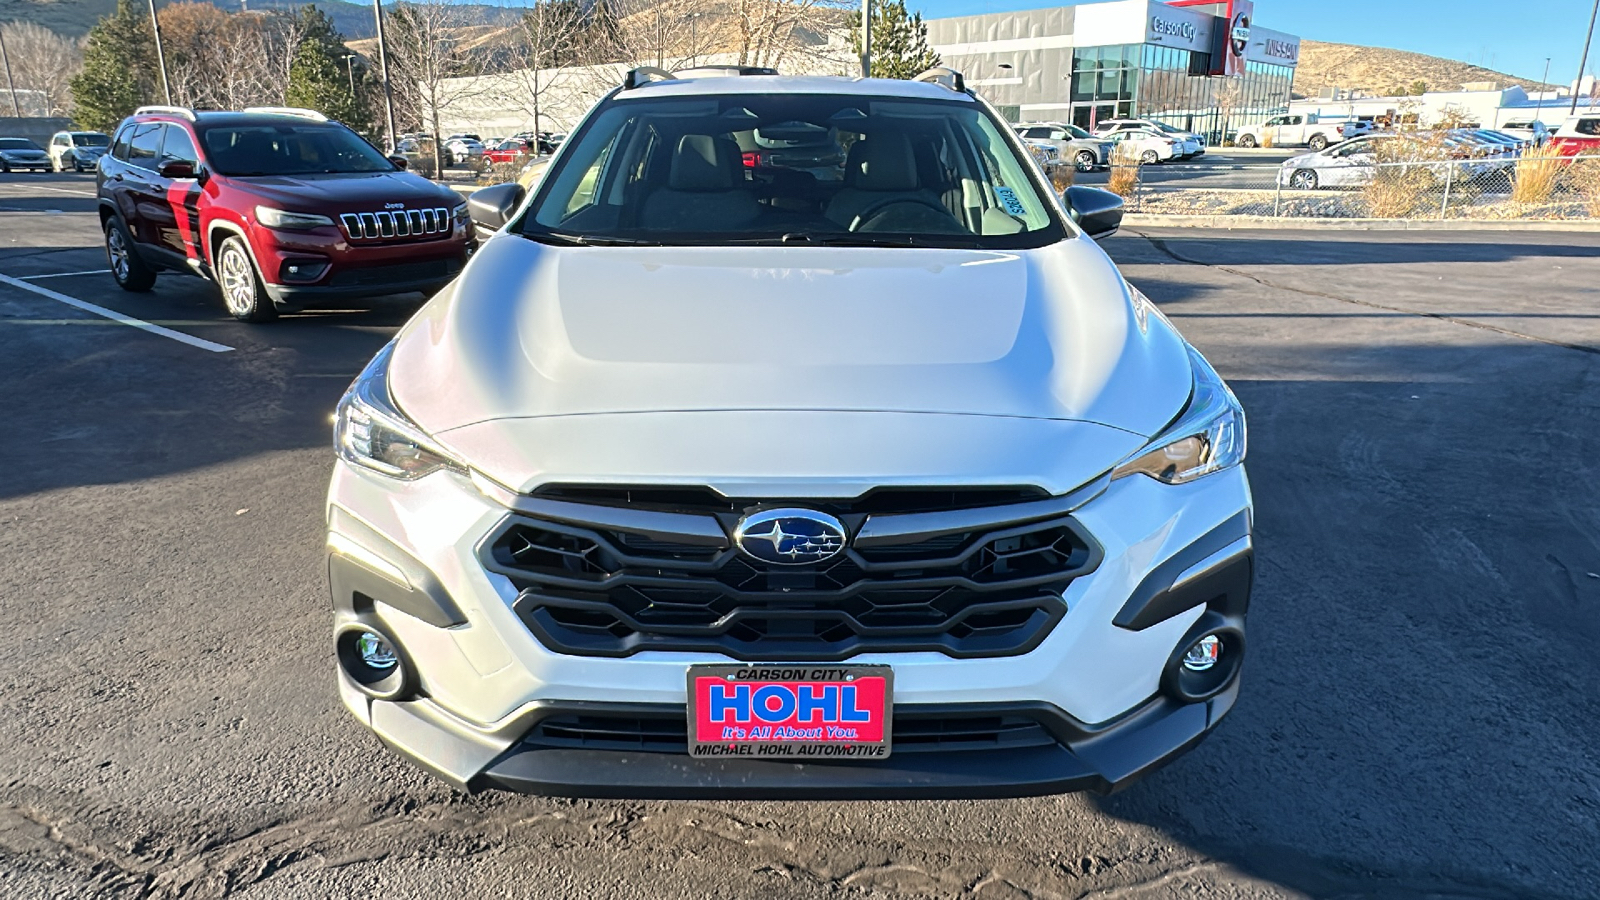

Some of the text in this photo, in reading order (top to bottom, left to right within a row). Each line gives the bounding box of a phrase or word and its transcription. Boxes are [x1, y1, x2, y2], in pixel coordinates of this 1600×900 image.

[1152, 16, 1197, 42] Carson City
[1265, 39, 1298, 60] NISSAN
[736, 669, 848, 680] CARSON CITY
[709, 684, 870, 722] HOHL
[722, 726, 858, 738] It's All About You.
[694, 744, 886, 756] MICHAEL HOHL AUTOMOTIVE
